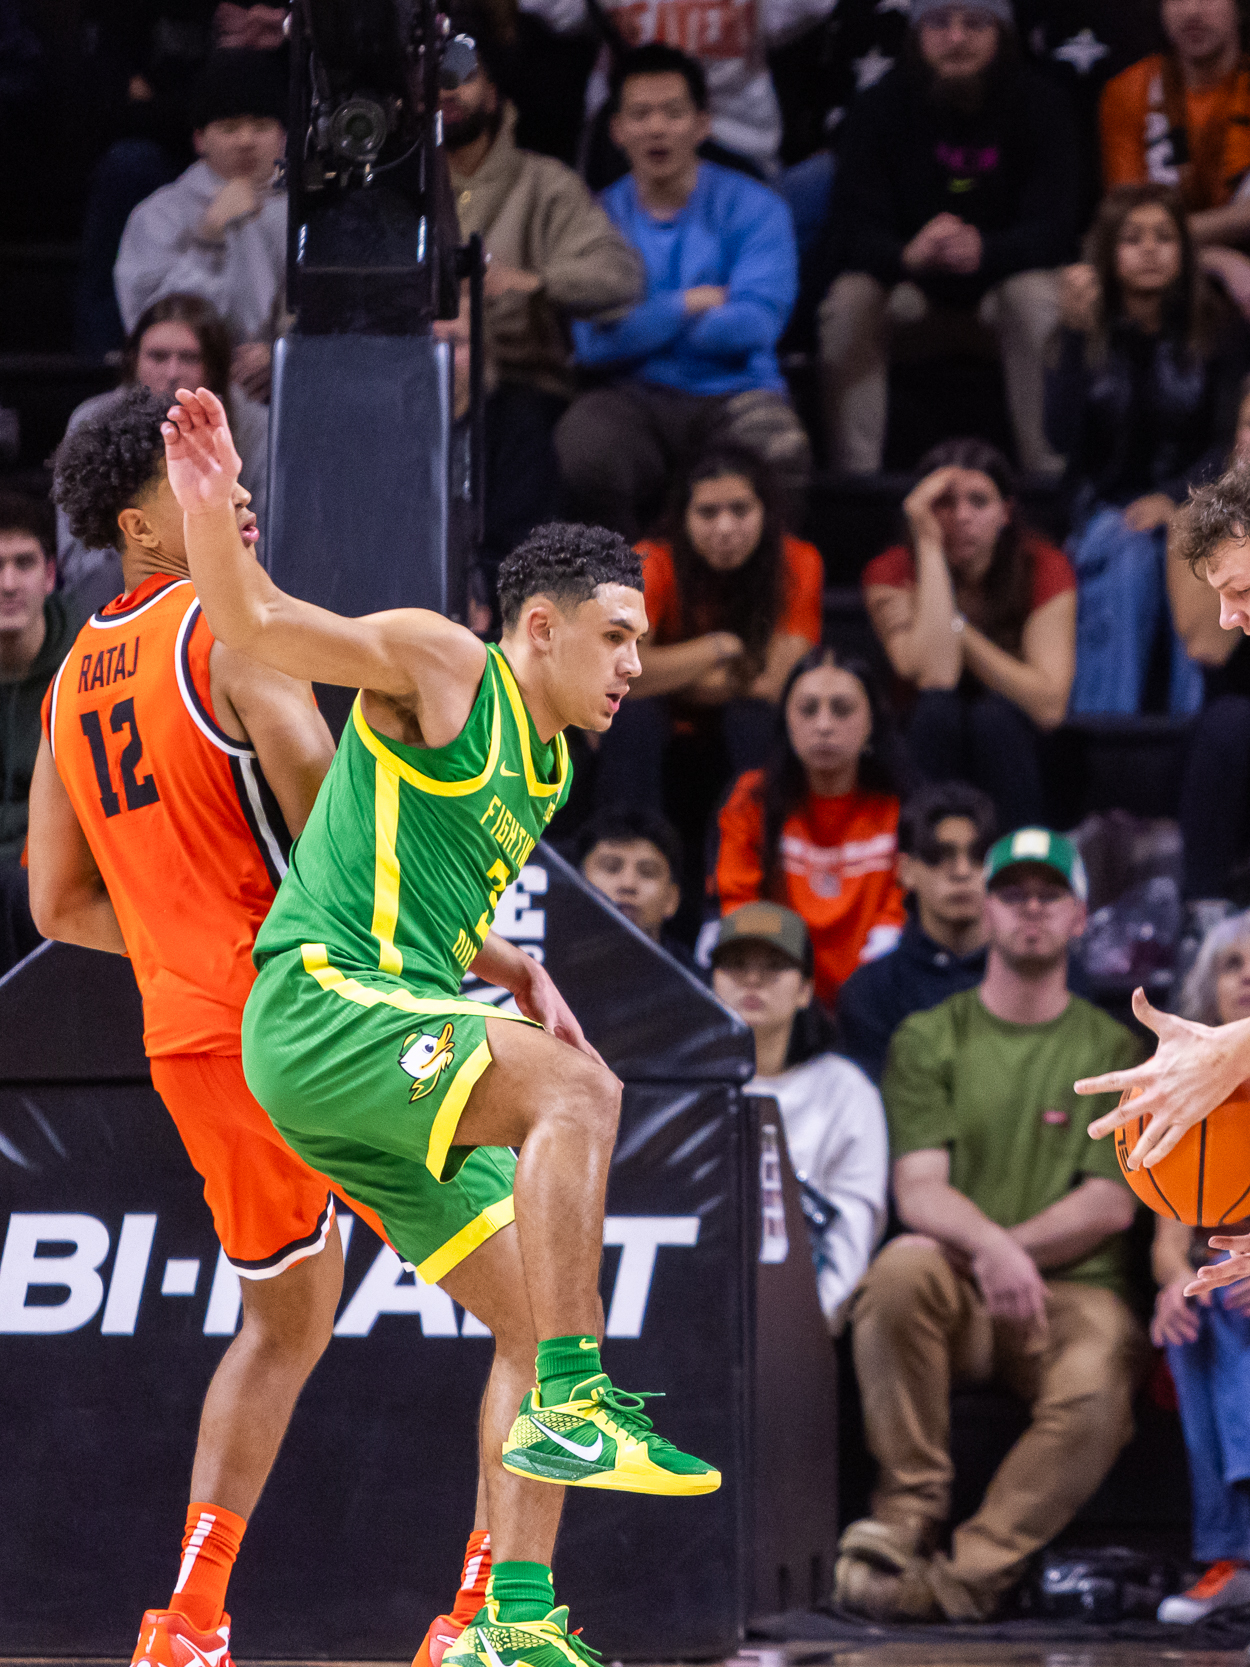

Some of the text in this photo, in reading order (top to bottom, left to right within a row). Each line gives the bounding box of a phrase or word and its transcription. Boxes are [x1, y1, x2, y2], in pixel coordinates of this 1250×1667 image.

[78, 636, 140, 693] RATAJ
[79, 696, 161, 819] 12
[0, 1213, 699, 1338] BI-AT
